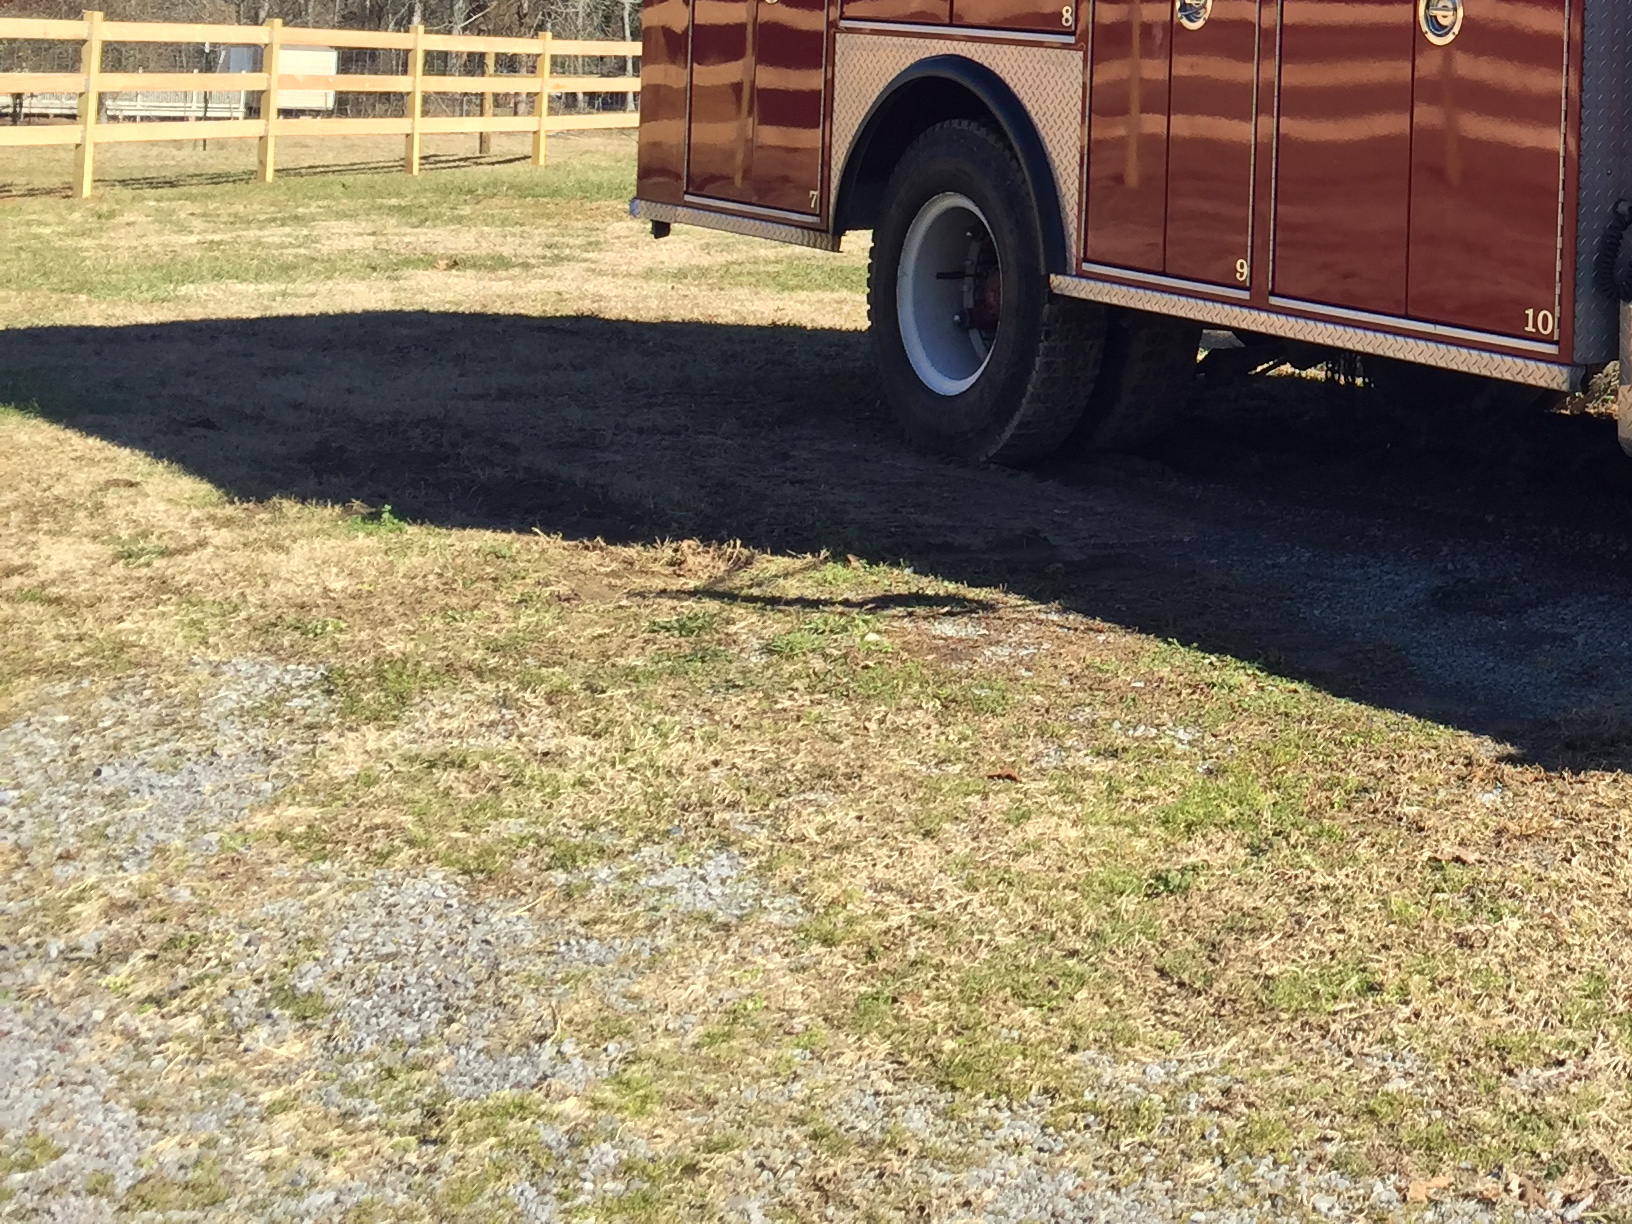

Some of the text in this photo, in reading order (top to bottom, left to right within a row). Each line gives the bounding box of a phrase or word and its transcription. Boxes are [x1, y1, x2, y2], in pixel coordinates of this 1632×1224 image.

[1062, 6, 1072, 26] 8
[809, 190, 818, 208] 7
[1236, 258, 1248, 281] 9
[1524, 308, 1553, 335] 10
